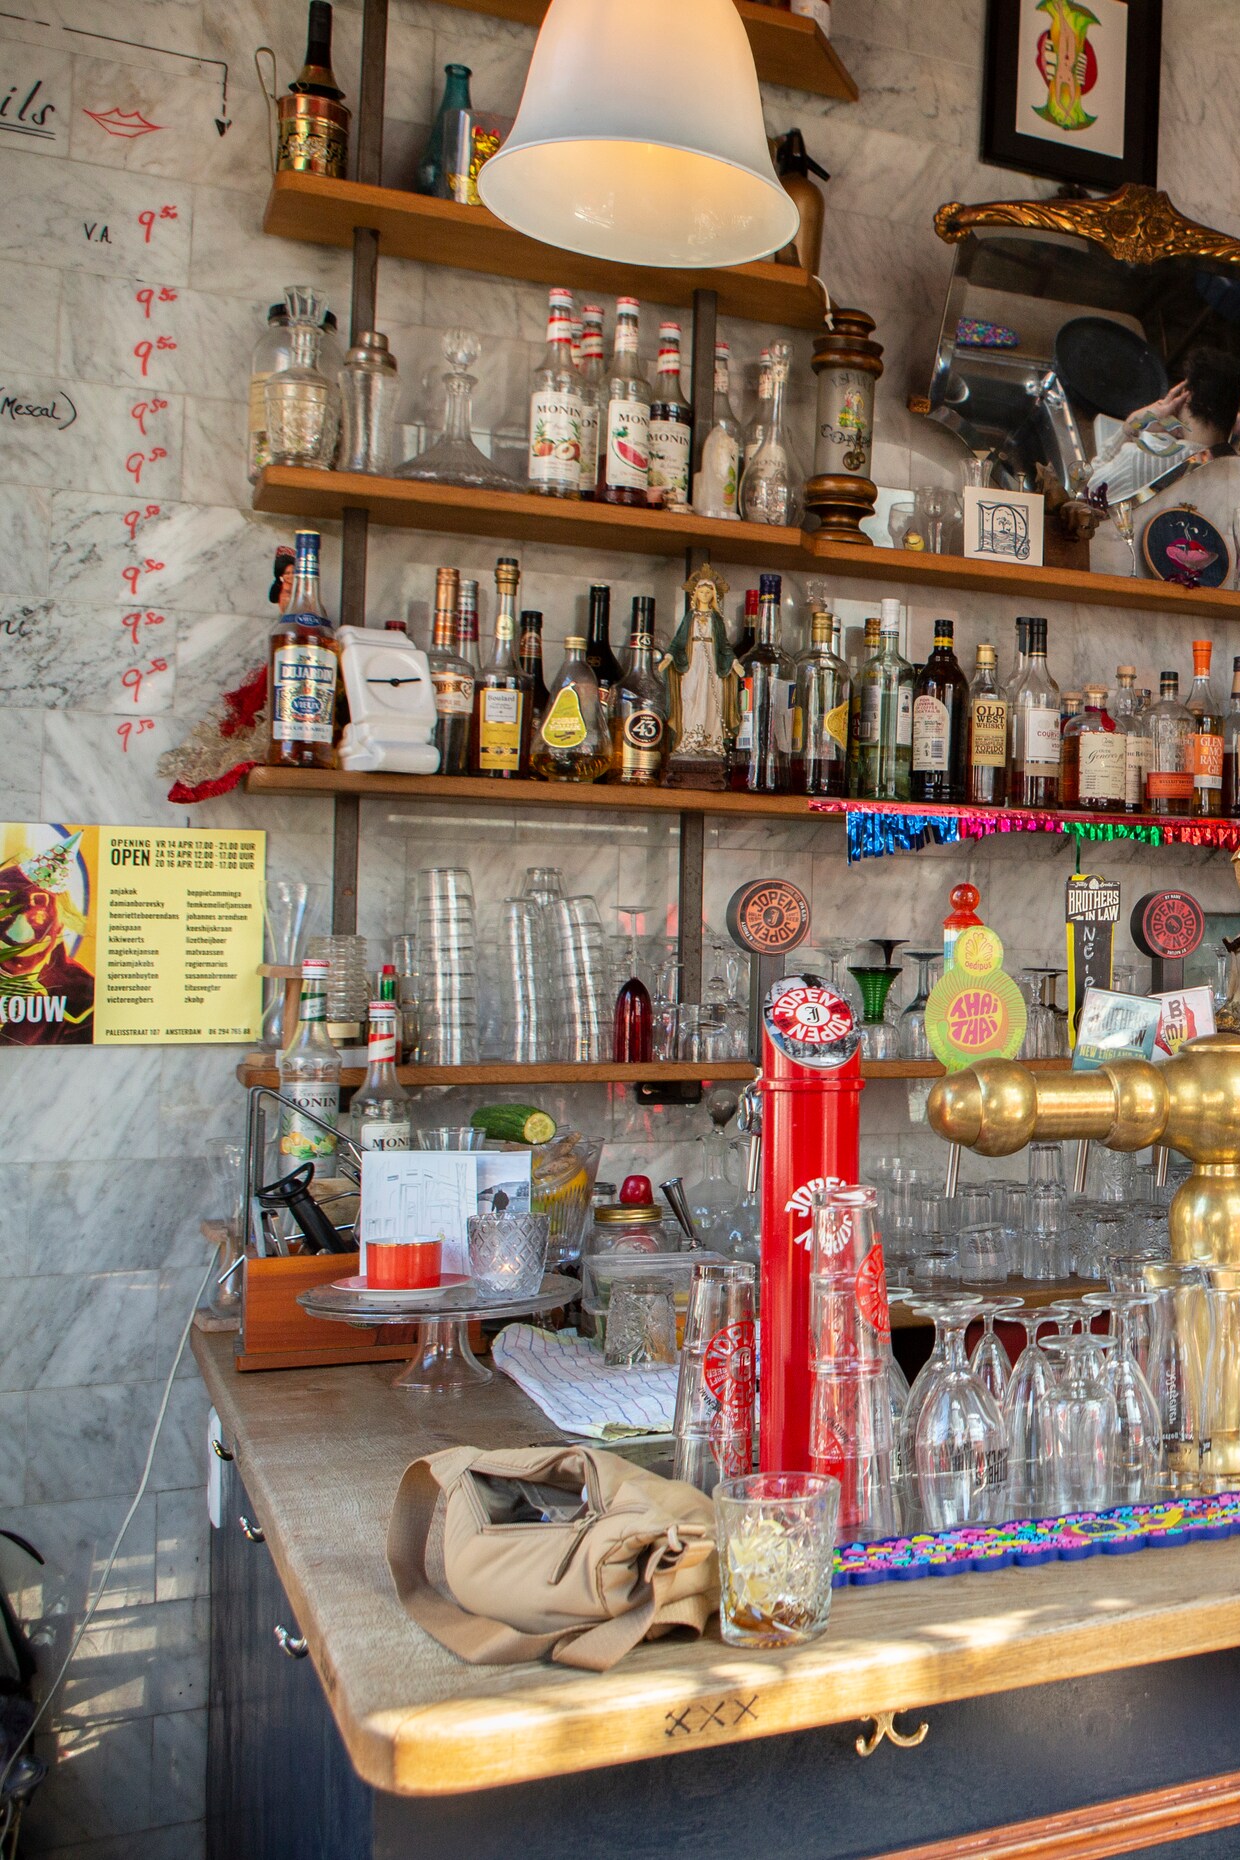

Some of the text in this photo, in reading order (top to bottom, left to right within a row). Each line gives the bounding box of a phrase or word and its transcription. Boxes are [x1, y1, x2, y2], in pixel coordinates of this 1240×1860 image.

[537, 404, 581, 418] MONIN
[618, 413, 650, 426] MON
[650, 432, 690, 446] MONIN
[281, 664, 333, 682] DUJARDIN
[291, 700, 322, 713] VIEUX
[976, 705, 1005, 717] OLD
[976, 715, 1005, 724] WEST
[976, 722, 1005, 730] WHISKY
[632, 719, 657, 738] 43
[1200, 736, 1222, 748] GLEN
[1208, 746, 1222, 756] MO
[1200, 755, 1218, 765] RAN
[1208, 763, 1220, 774] GIE
[110, 838, 151, 848] OPENING
[155, 840, 166, 848] VR
[168, 840, 176, 848] 14
[177, 841, 193, 849] APR
[240, 842, 256, 850] UUR
[110, 848, 151, 866] OPEN
[155, 849, 164, 858] ZA
[167, 850, 175, 858] 15
[177, 850, 192, 858] APR
[239, 852, 255, 860] UUR
[155, 859, 164, 867] ZO
[167, 860, 175, 868] 16
[177, 860, 192, 868] APR
[239, 862, 255, 870] UUR
[751, 891, 797, 913] JOPEN
[1068, 889, 1120, 915] BROTHERS
[1085, 904, 1119, 920] IN LAW
[1152, 901, 1176, 940] JOPEN
[750, 922, 797, 943] JOPEN
[1173, 909, 1195, 949] JOPEN
[964, 959, 992, 971] oedipus
[774, 988, 840, 1017] JOPEN
[105, 1028, 148, 1036] PALEISSTRAAT
[786, 1014, 851, 1042] JOPEN
[1078, 1045, 1098, 1058] NEW
[372, 1137, 410, 1148] MONI
[784, 1176, 848, 1218] JOPE
